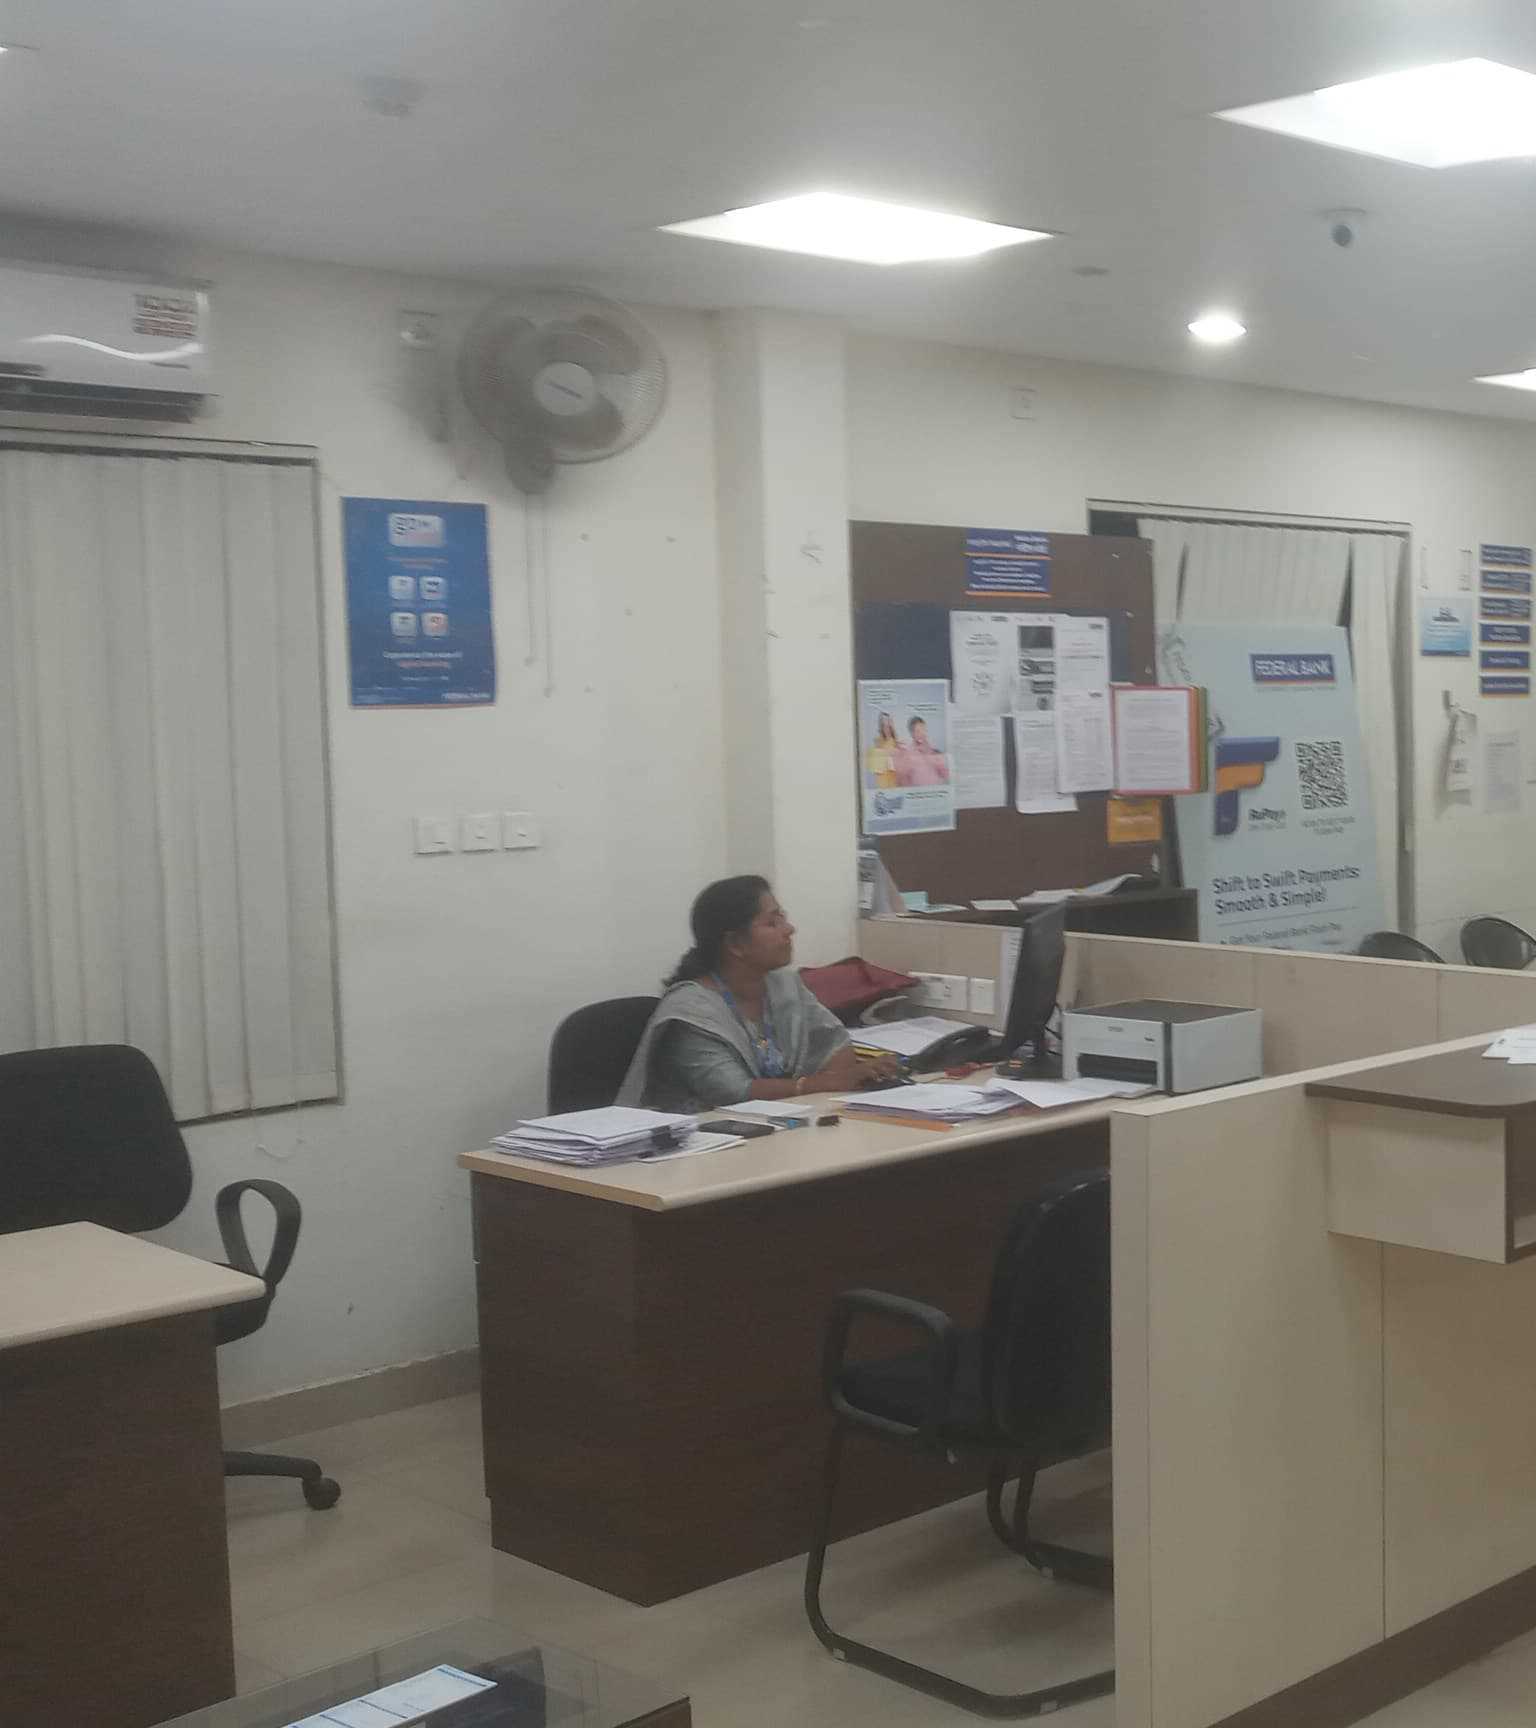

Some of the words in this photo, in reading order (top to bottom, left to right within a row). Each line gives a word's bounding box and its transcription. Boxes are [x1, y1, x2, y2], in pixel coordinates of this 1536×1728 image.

[1255, 659, 1299, 675] FEDERAL
[1301, 659, 1330, 675] BANK
[1212, 876, 1245, 894] Shift
[1246, 876, 1261, 890] to
[1262, 869, 1298, 888] Swift
[1215, 894, 1265, 915] Smooth
[1269, 892, 1280, 908] &
